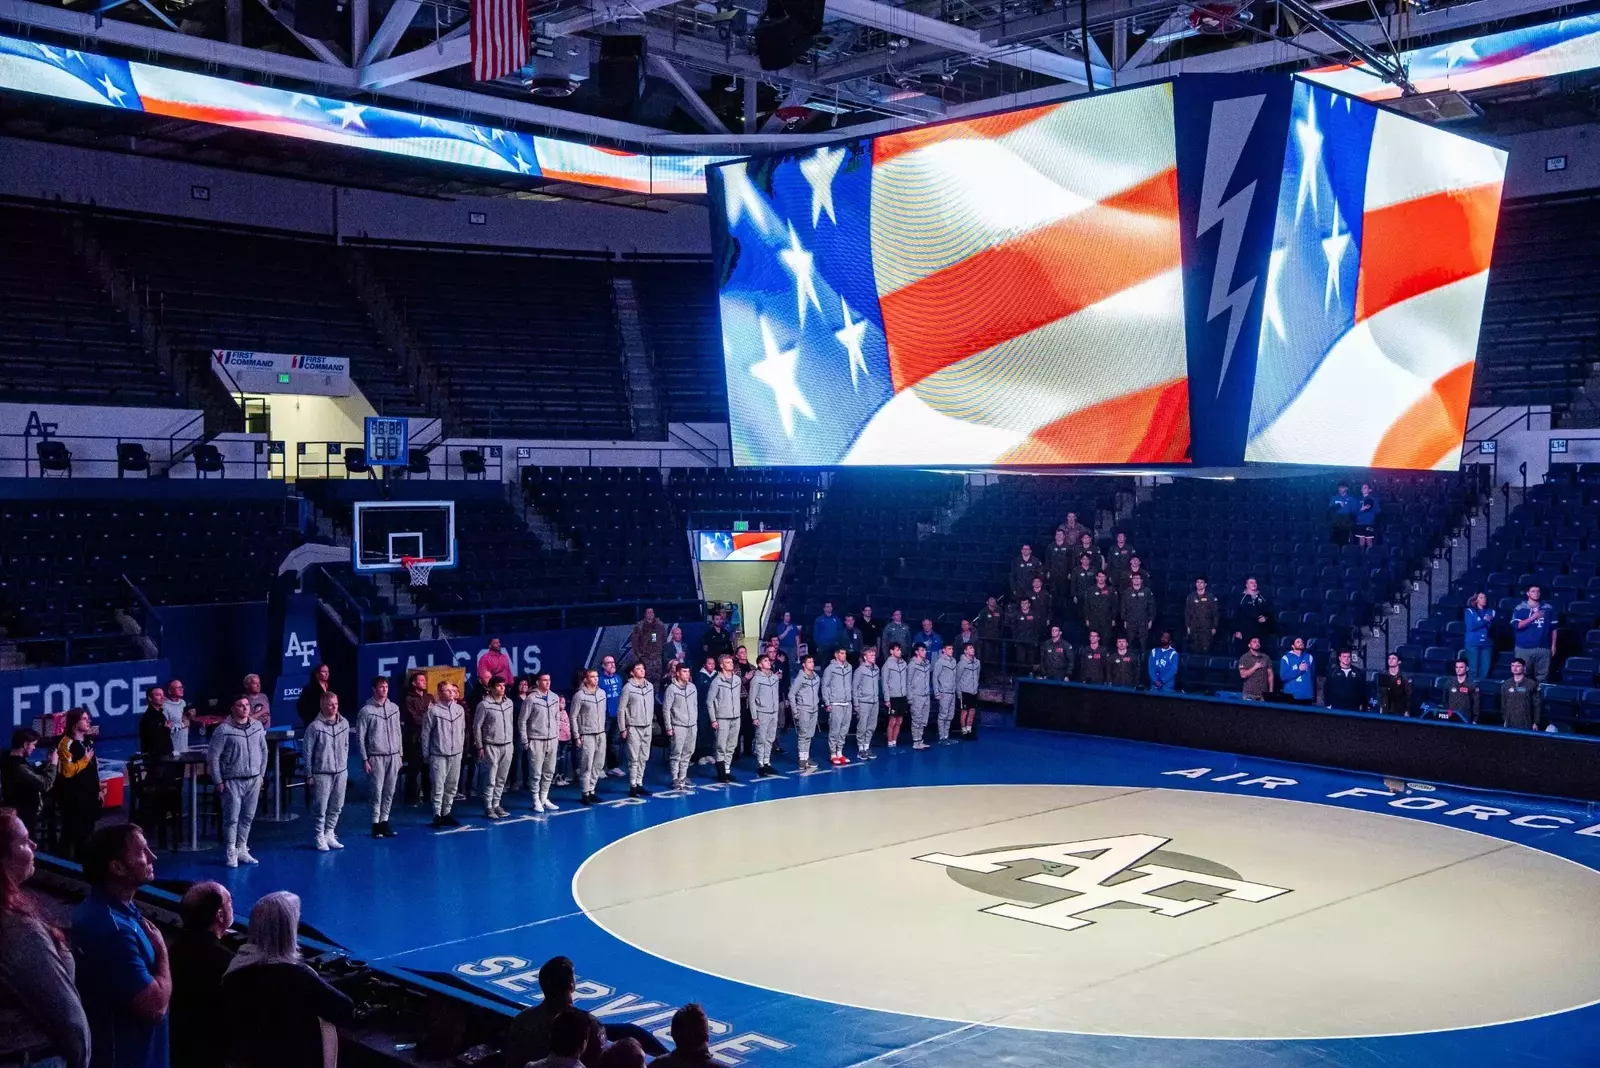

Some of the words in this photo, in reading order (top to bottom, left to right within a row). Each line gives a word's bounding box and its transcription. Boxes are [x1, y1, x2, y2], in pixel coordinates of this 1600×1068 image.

[230, 358, 274, 368] COMMAND
[232, 351, 254, 359] FIRST
[304, 362, 345, 372] COMMAND
[305, 355, 327, 364] FIRST
[23, 410, 59, 443] AF
[284, 631, 318, 667] AF
[377, 644, 542, 683] FCNS
[12, 675, 158, 727] FORCE
[1160, 767, 1299, 790] AIR
[911, 832, 1296, 932] AF
